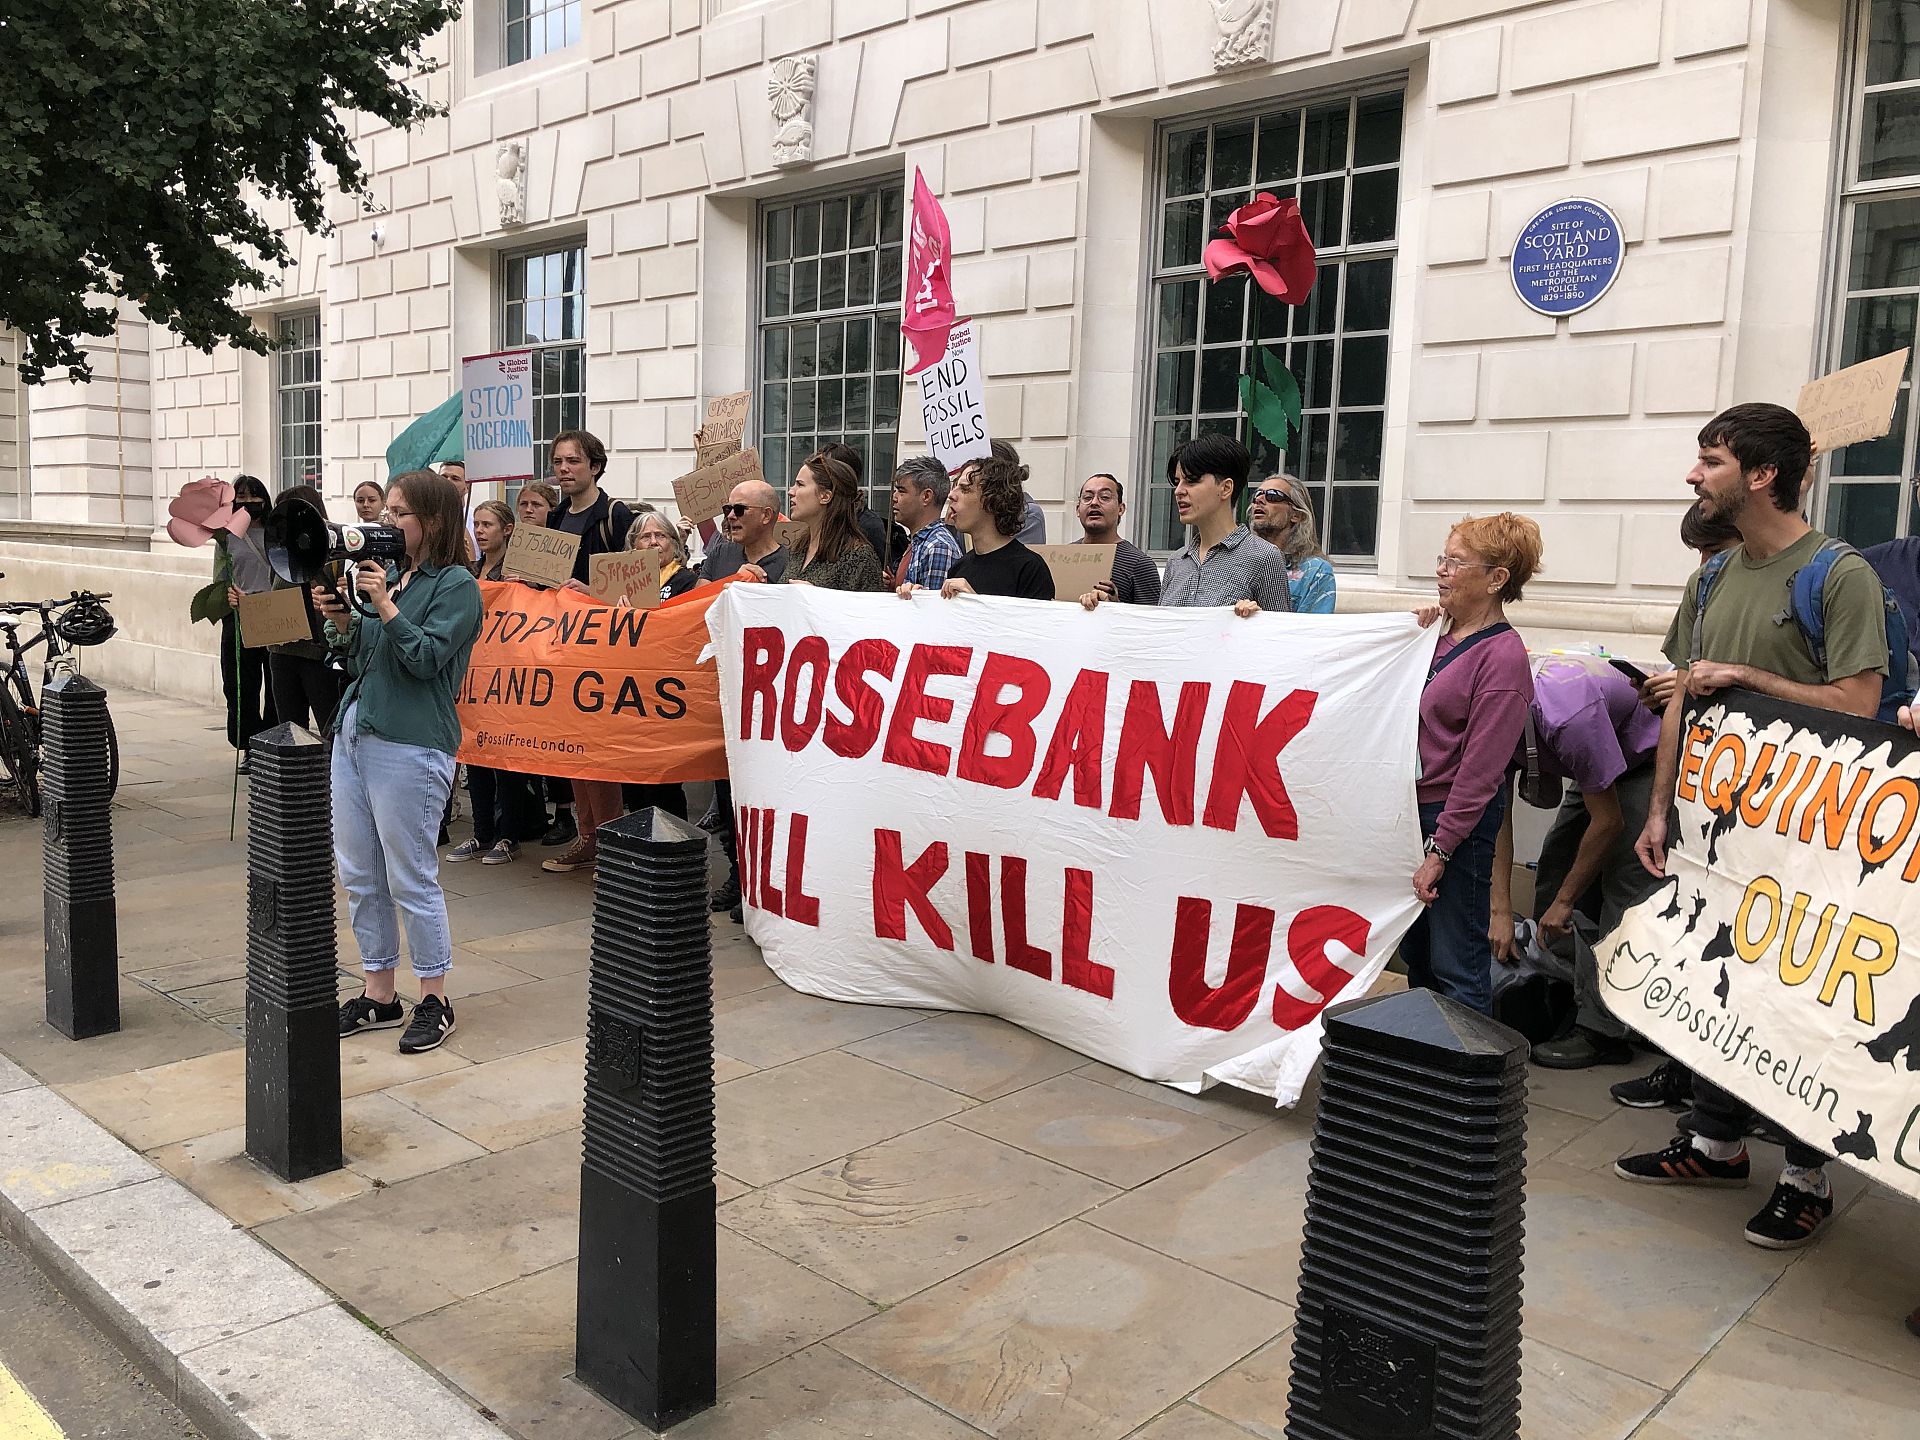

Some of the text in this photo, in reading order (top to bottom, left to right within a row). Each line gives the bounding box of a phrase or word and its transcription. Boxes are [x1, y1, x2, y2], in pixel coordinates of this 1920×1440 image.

[1529, 205, 1607, 232] GREATER LONDON COUNCIL
[1551, 220, 1584, 231] SITE OF
[1524, 227, 1611, 249] SCOTLAND
[1519, 256, 1613, 273] FIRST HEADQUARTERS
[1543, 244, 1589, 261] YARD
[1531, 274, 1598, 287] METROPOLITAN
[1548, 268, 1579, 278] OF THE
[1541, 291, 1585, 302] 1829-1890
[1548, 284, 1578, 293] POLICE
[949, 328, 971, 342] Global
[951, 336, 972, 350] Justice
[506, 358, 528, 367] Global
[952, 348, 964, 358] Now
[506, 365, 528, 374] Justice
[921, 358, 968, 401] END
[469, 384, 523, 419] STOP
[922, 389, 979, 432] FOSSIL
[466, 419, 532, 451] ROSEBANK
[930, 414, 985, 458] FUELS
[626, 572, 652, 598] BANK
[476, 608, 649, 647] TOP NEW
[483, 667, 554, 707] AND
[572, 670, 687, 720] GAS
[476, 730, 585, 755] @FossilFreeLondon
[740, 626, 1319, 841] ROSEBANK
[1677, 723, 1920, 883] EQUINO
[872, 827, 1115, 1001] KILL
[1169, 895, 1373, 1032] US
[1734, 875, 1900, 1026] OUR
[1644, 976, 1840, 1123] @fossilfreeldn
